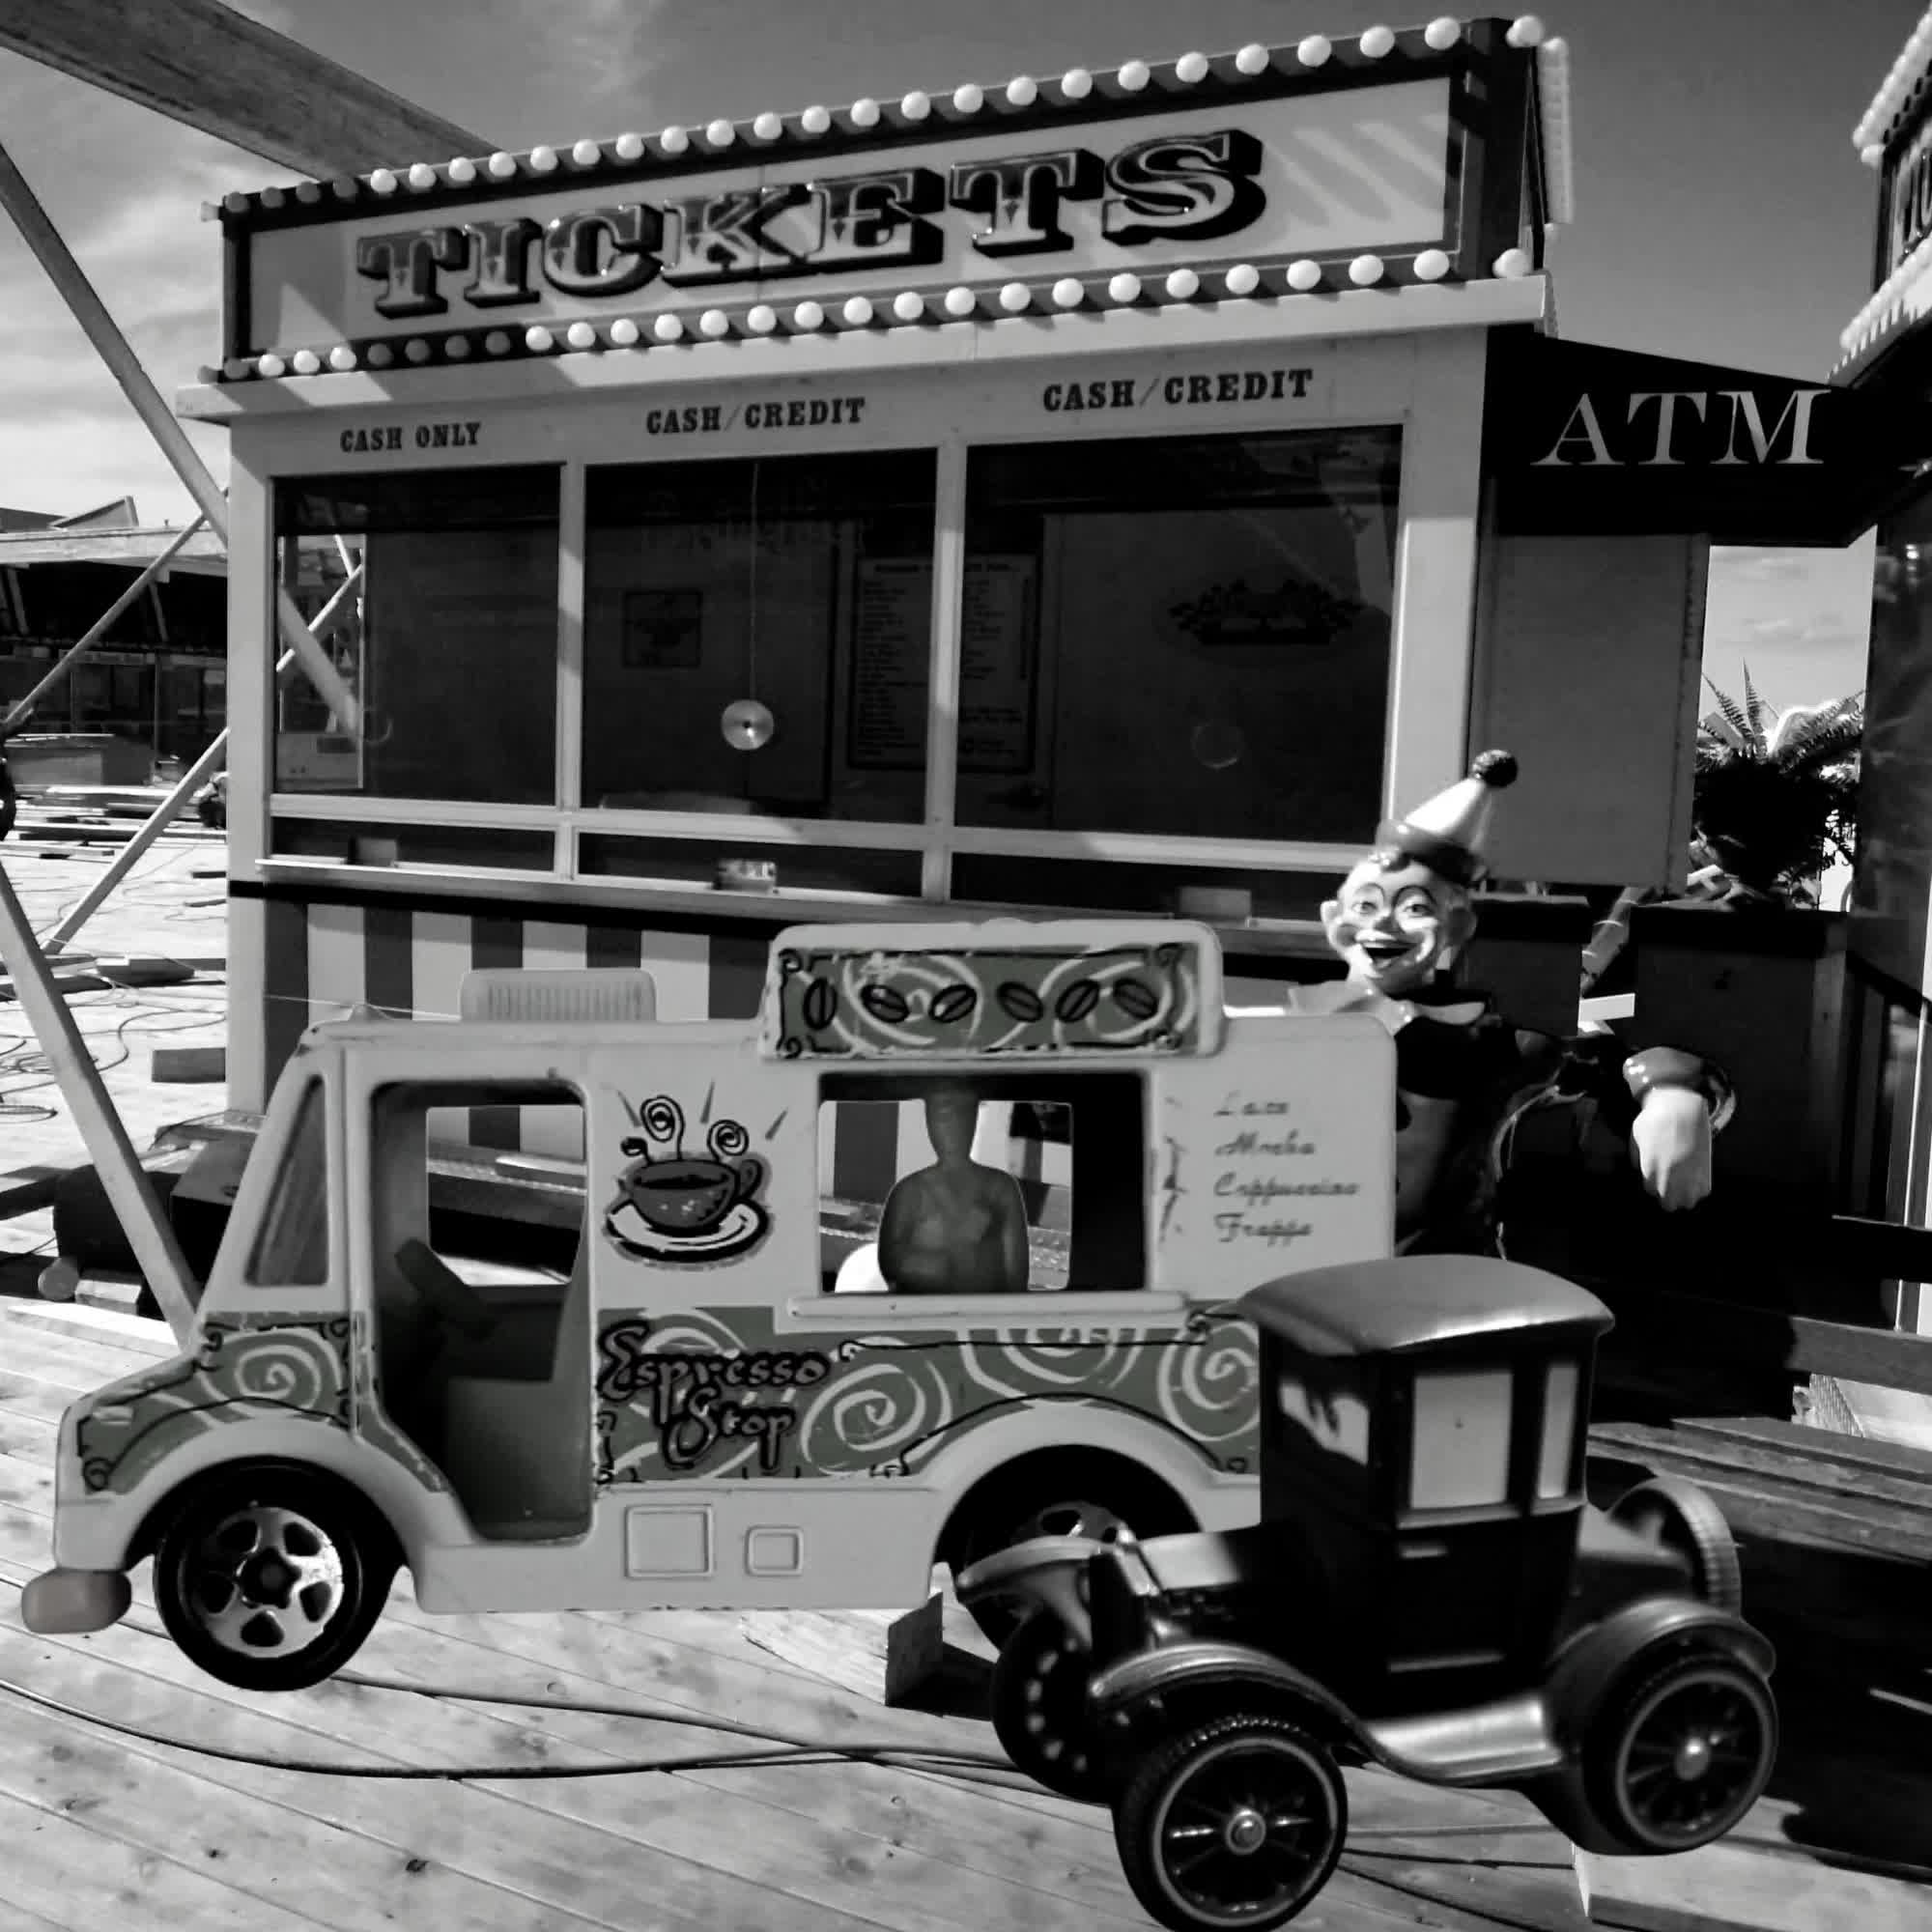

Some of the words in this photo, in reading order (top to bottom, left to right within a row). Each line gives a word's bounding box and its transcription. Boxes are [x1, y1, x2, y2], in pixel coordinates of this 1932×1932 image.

[356, 128, 1267, 319] TICKETS
[645, 397, 867, 435] CASH/CREDIT
[1042, 368, 1314, 412] CASH/CREDIT
[1529, 388, 1833, 467] ATM
[340, 428, 403, 453] CASH
[415, 421, 481, 448] ONLY
[595, 1319, 832, 1430] Espresso
[661, 1381, 797, 1476] Stop
